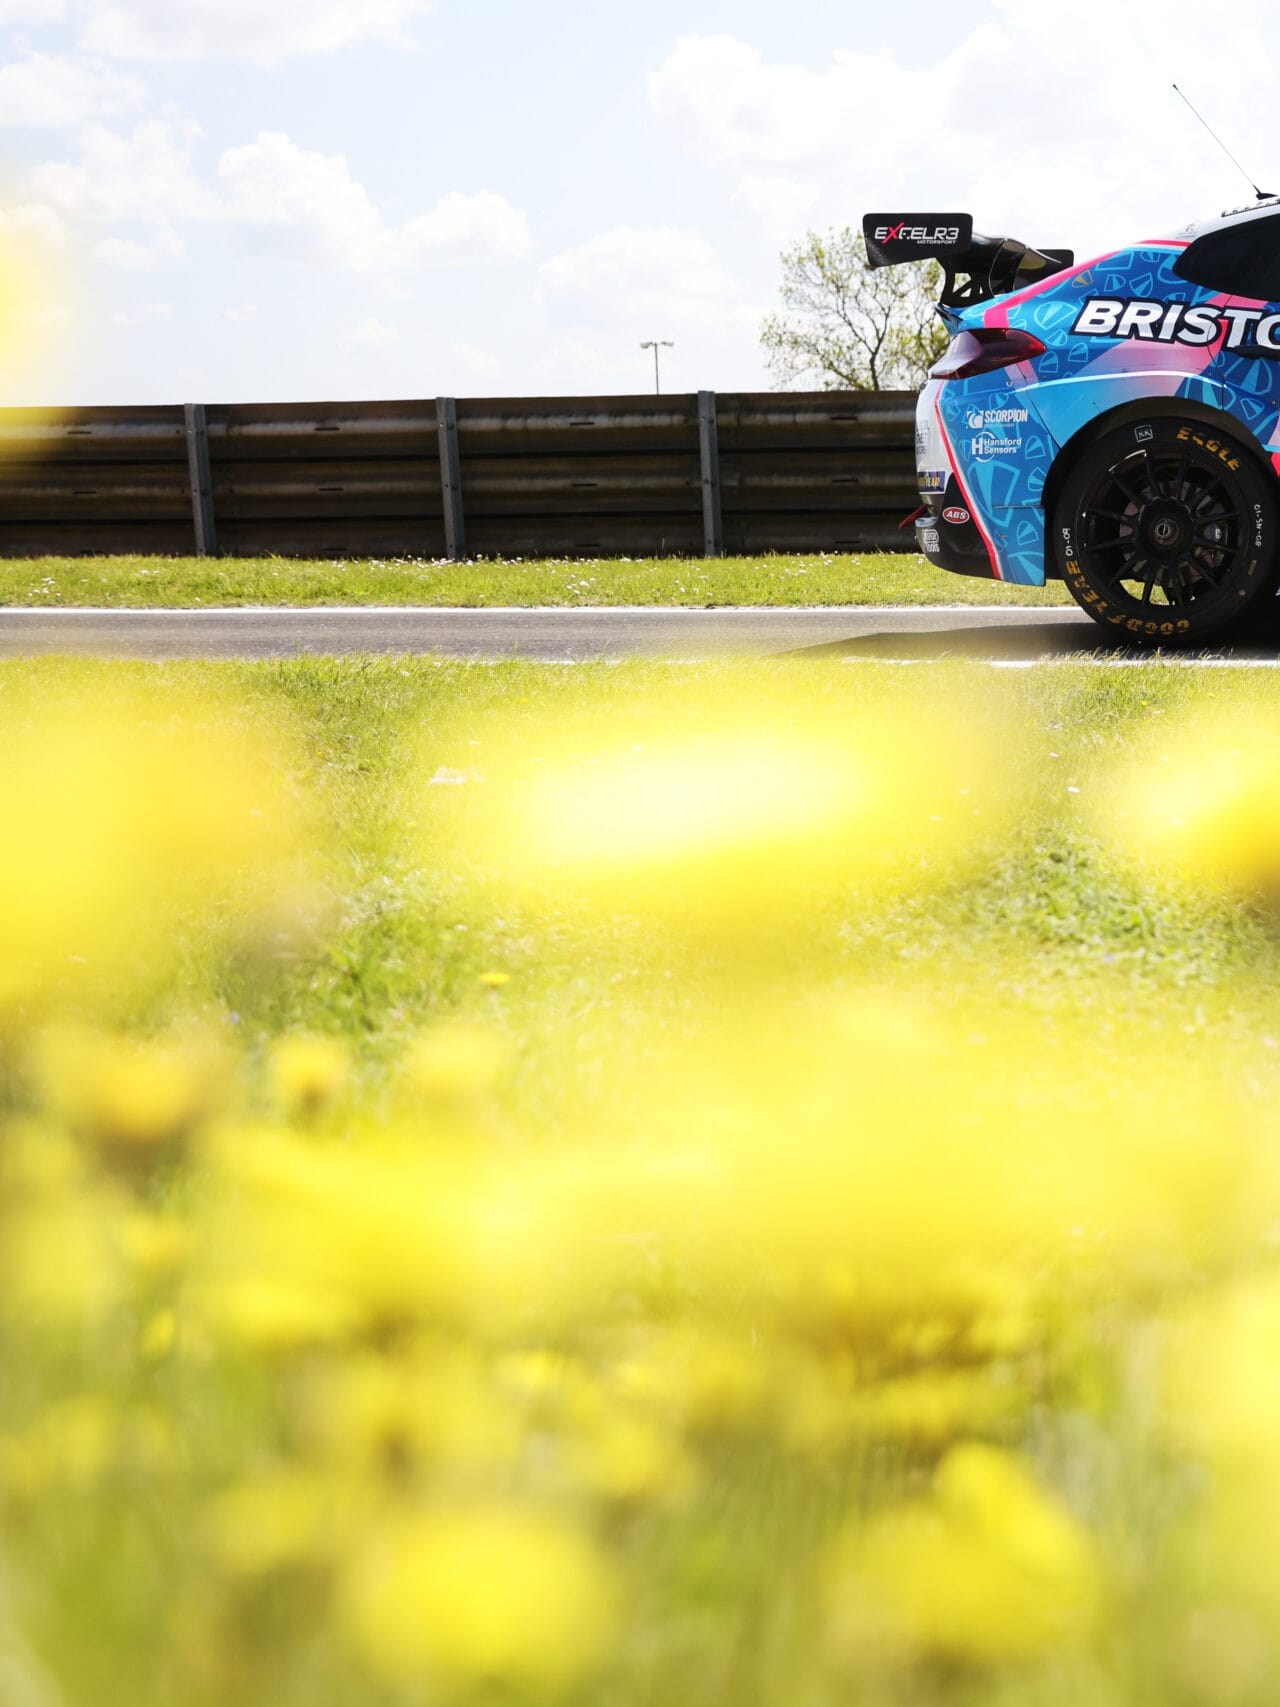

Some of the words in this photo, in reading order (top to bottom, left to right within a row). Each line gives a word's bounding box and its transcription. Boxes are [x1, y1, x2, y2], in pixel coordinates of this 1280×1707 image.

[984, 409, 1028, 423] SCORPION
[983, 437, 1022, 446] Hansford
[983, 446, 1017, 455] Sensors
[946, 510, 967, 520] ABS
